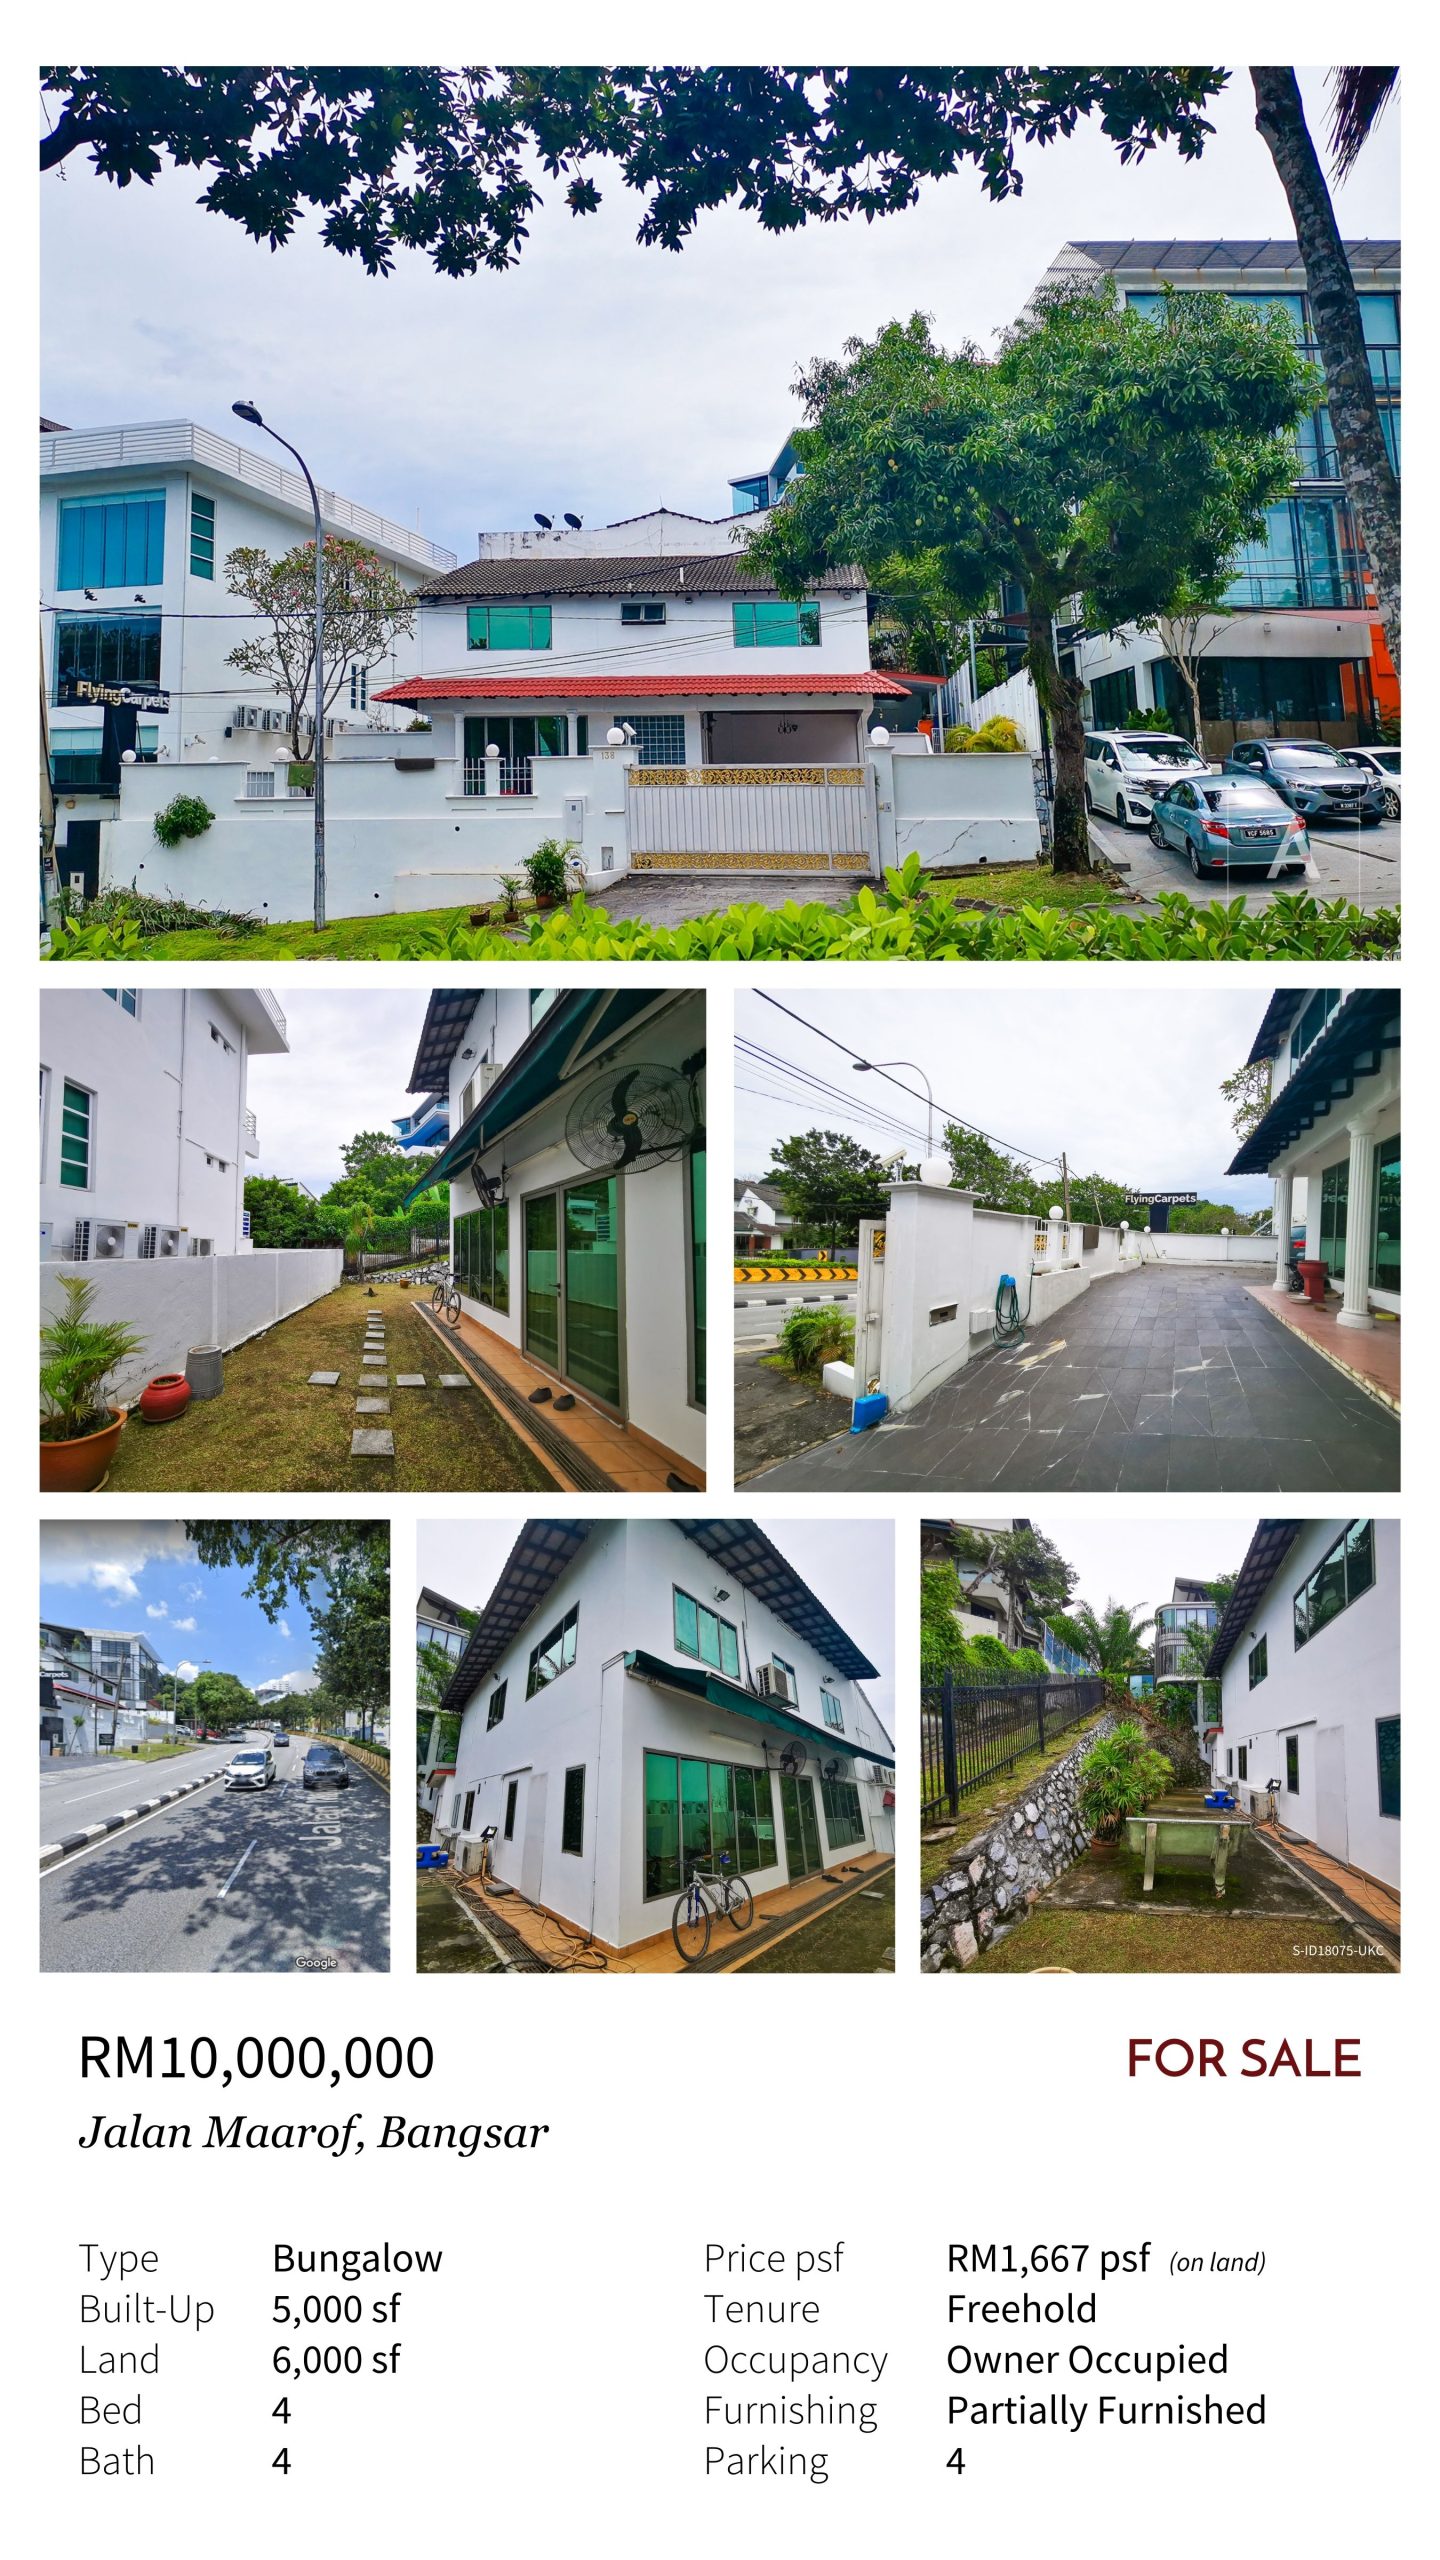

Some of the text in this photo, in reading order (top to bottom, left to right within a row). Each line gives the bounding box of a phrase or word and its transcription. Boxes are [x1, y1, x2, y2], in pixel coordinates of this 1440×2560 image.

[76, 681, 171, 710] FlyingCarpets
[601, 751, 615, 760] 138
[1125, 1194, 1196, 1206] FlyingCarpets
